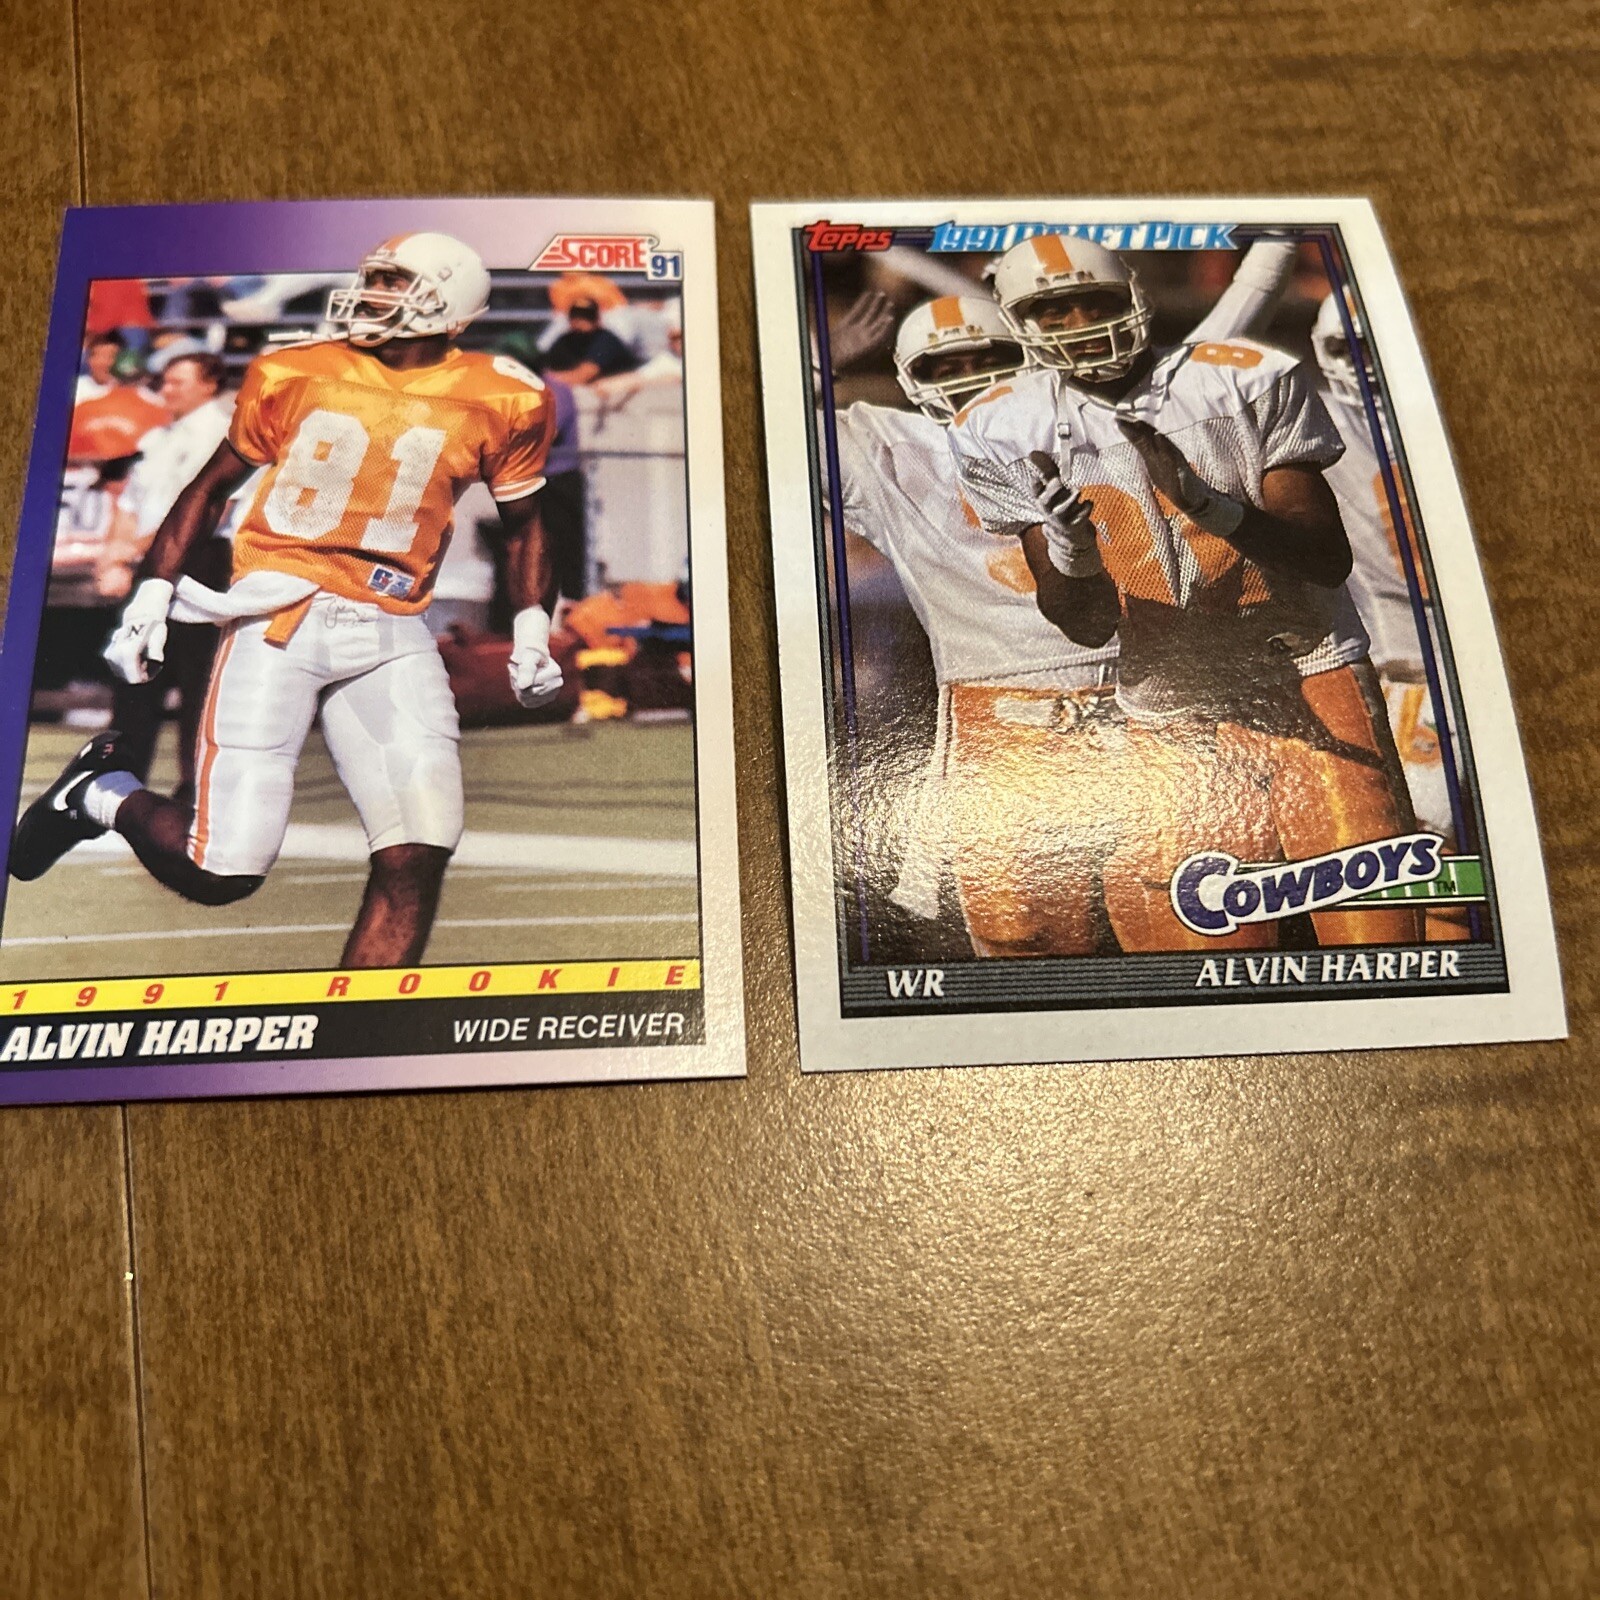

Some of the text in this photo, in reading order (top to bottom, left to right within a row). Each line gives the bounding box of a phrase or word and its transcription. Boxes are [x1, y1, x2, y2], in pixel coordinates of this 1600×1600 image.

[535, 238, 648, 268] SCORE
[928, 221, 1009, 252] 1991
[1142, 222, 1240, 250] PICK
[651, 255, 681, 277] 91
[263, 409, 447, 553] 81
[1176, 838, 1437, 930] COWBOYS
[1434, 880, 1457, 893] TM
[887, 968, 945, 998] WR
[1194, 949, 1461, 987] ALVIN HARPER
[13, 965, 686, 1010] 1991 ROOKIE
[0, 1014, 319, 1063] ALVIN HARPER
[453, 1011, 685, 1044] WIDE RECEIVER
